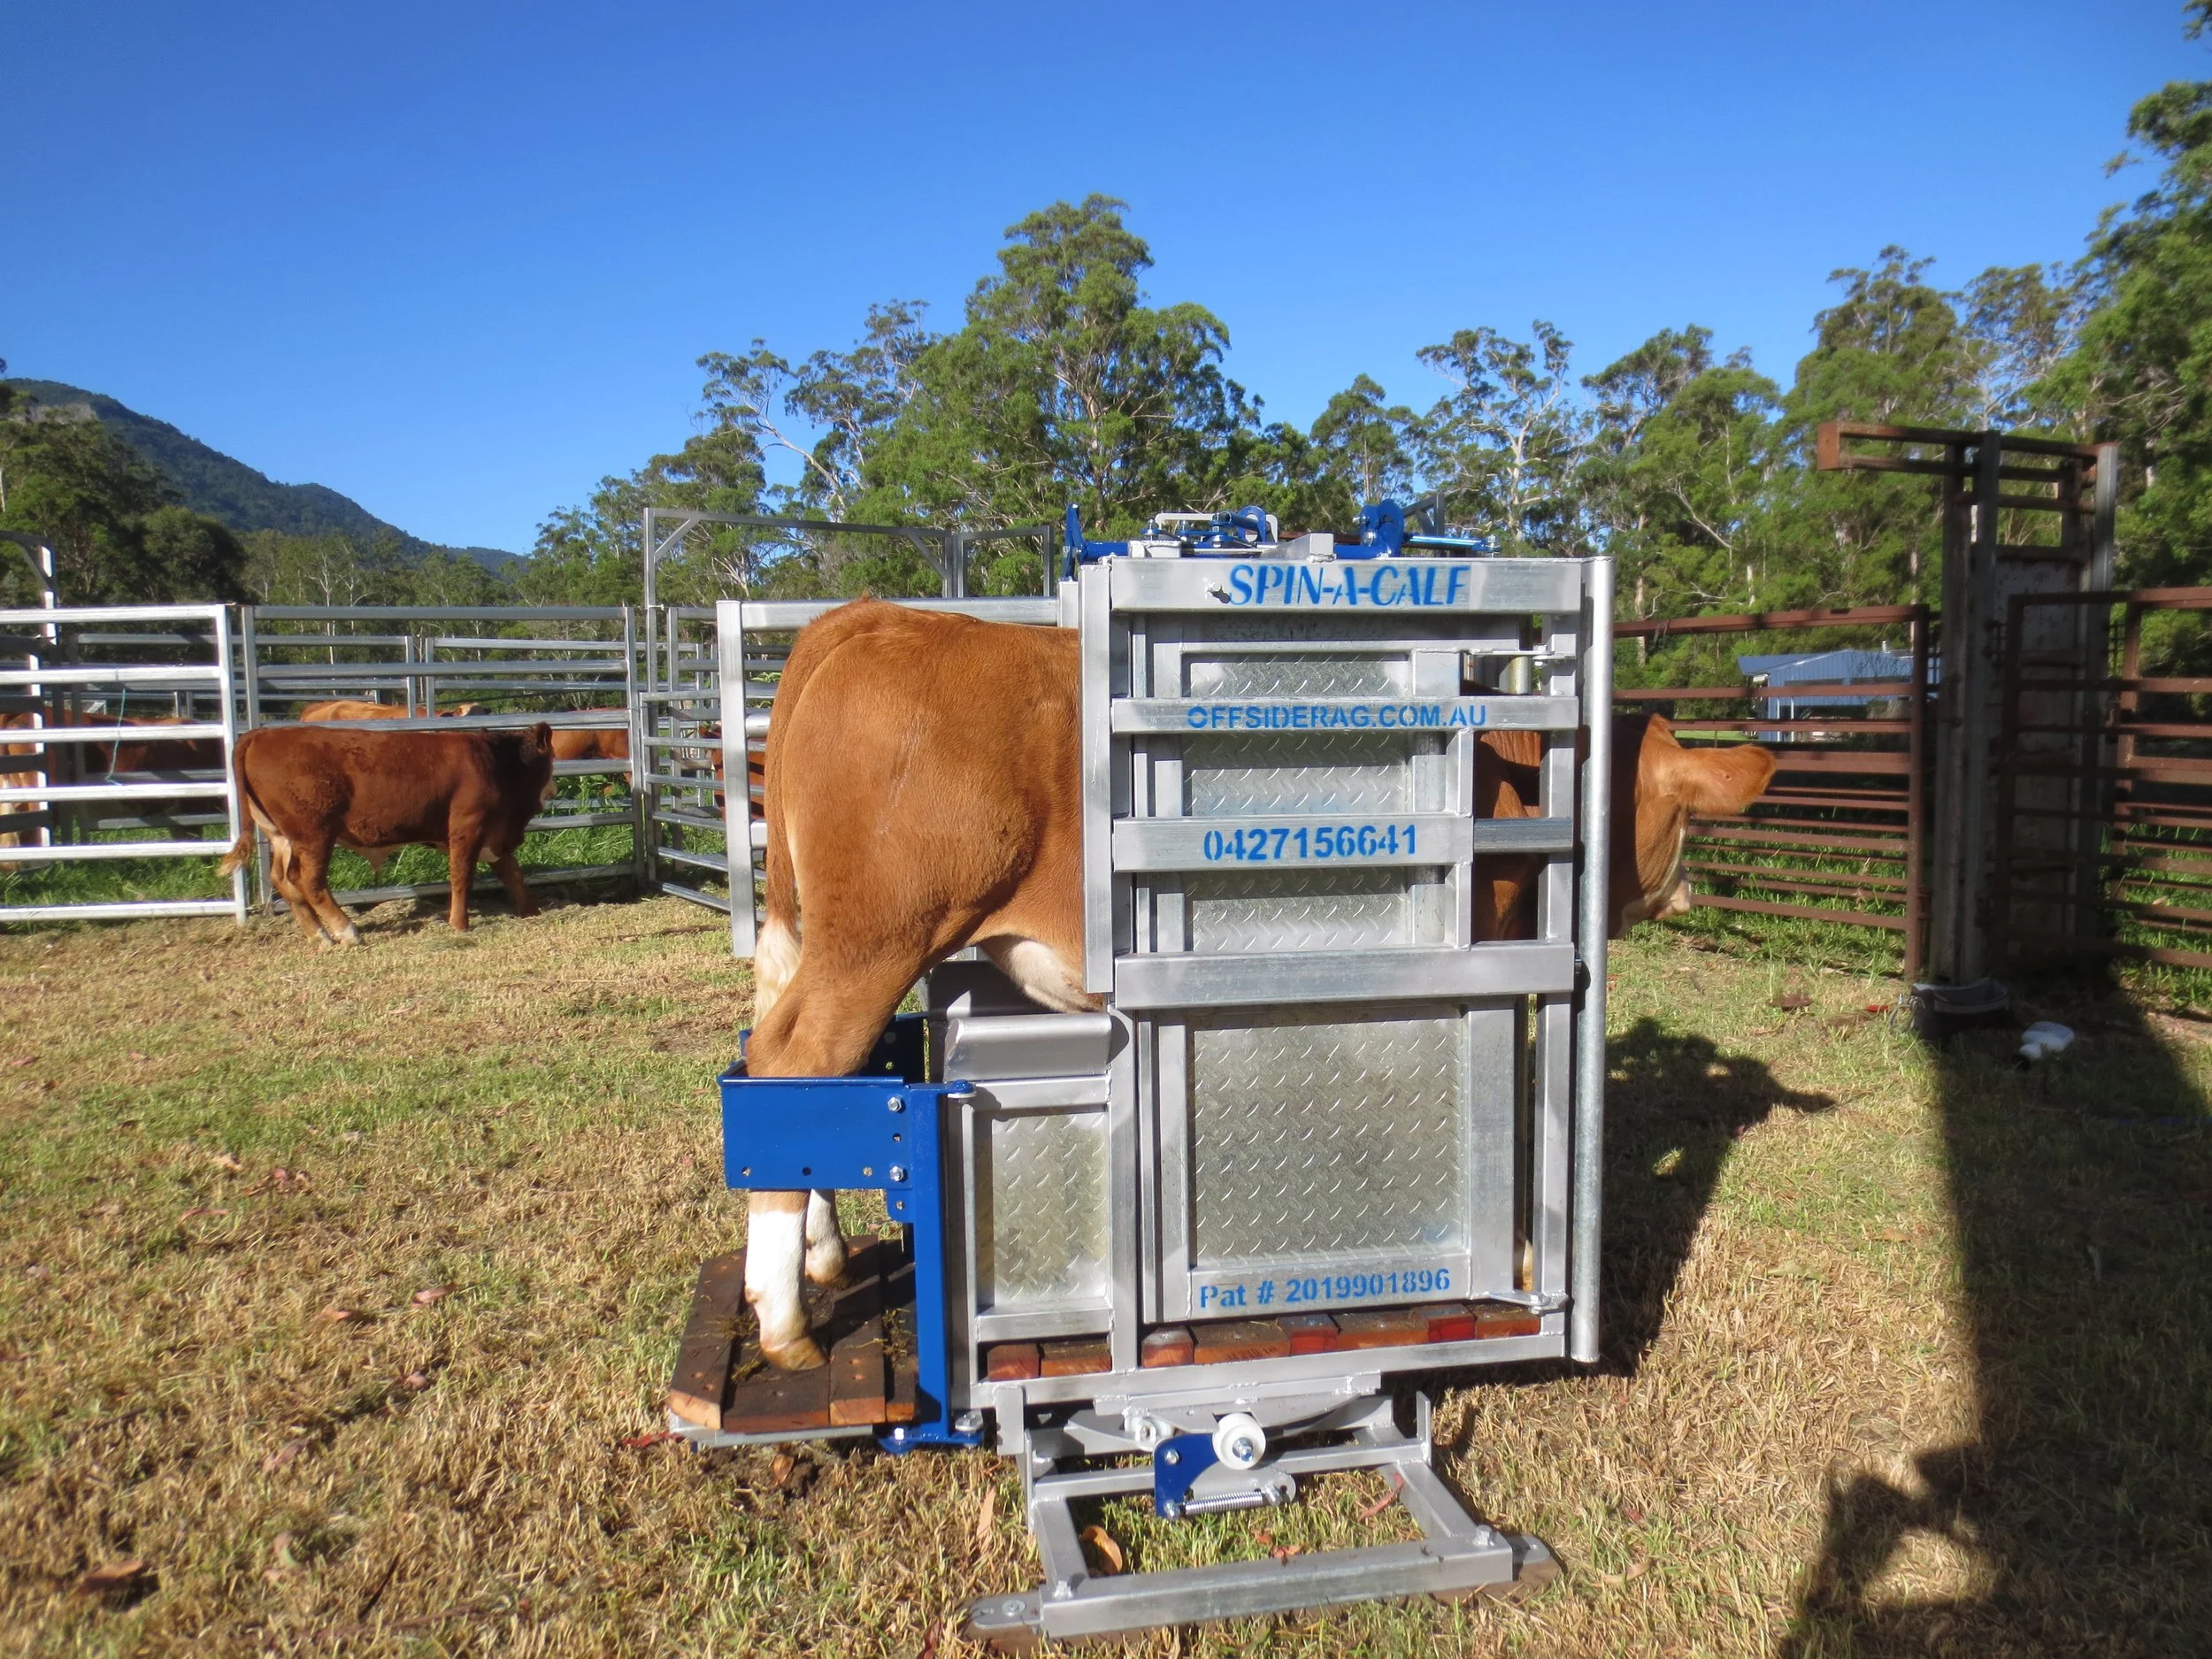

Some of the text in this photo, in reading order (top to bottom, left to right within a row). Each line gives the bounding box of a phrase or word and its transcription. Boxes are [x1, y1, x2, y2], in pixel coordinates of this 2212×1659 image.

[1228, 564, 1471, 607] SPIN-A-CALF
[1186, 704, 1486, 730] OFFSIDERAG.COM.AU
[1202, 823, 1417, 862] 0427156641
[1200, 1268, 1451, 1309] Pat # 2019901896
